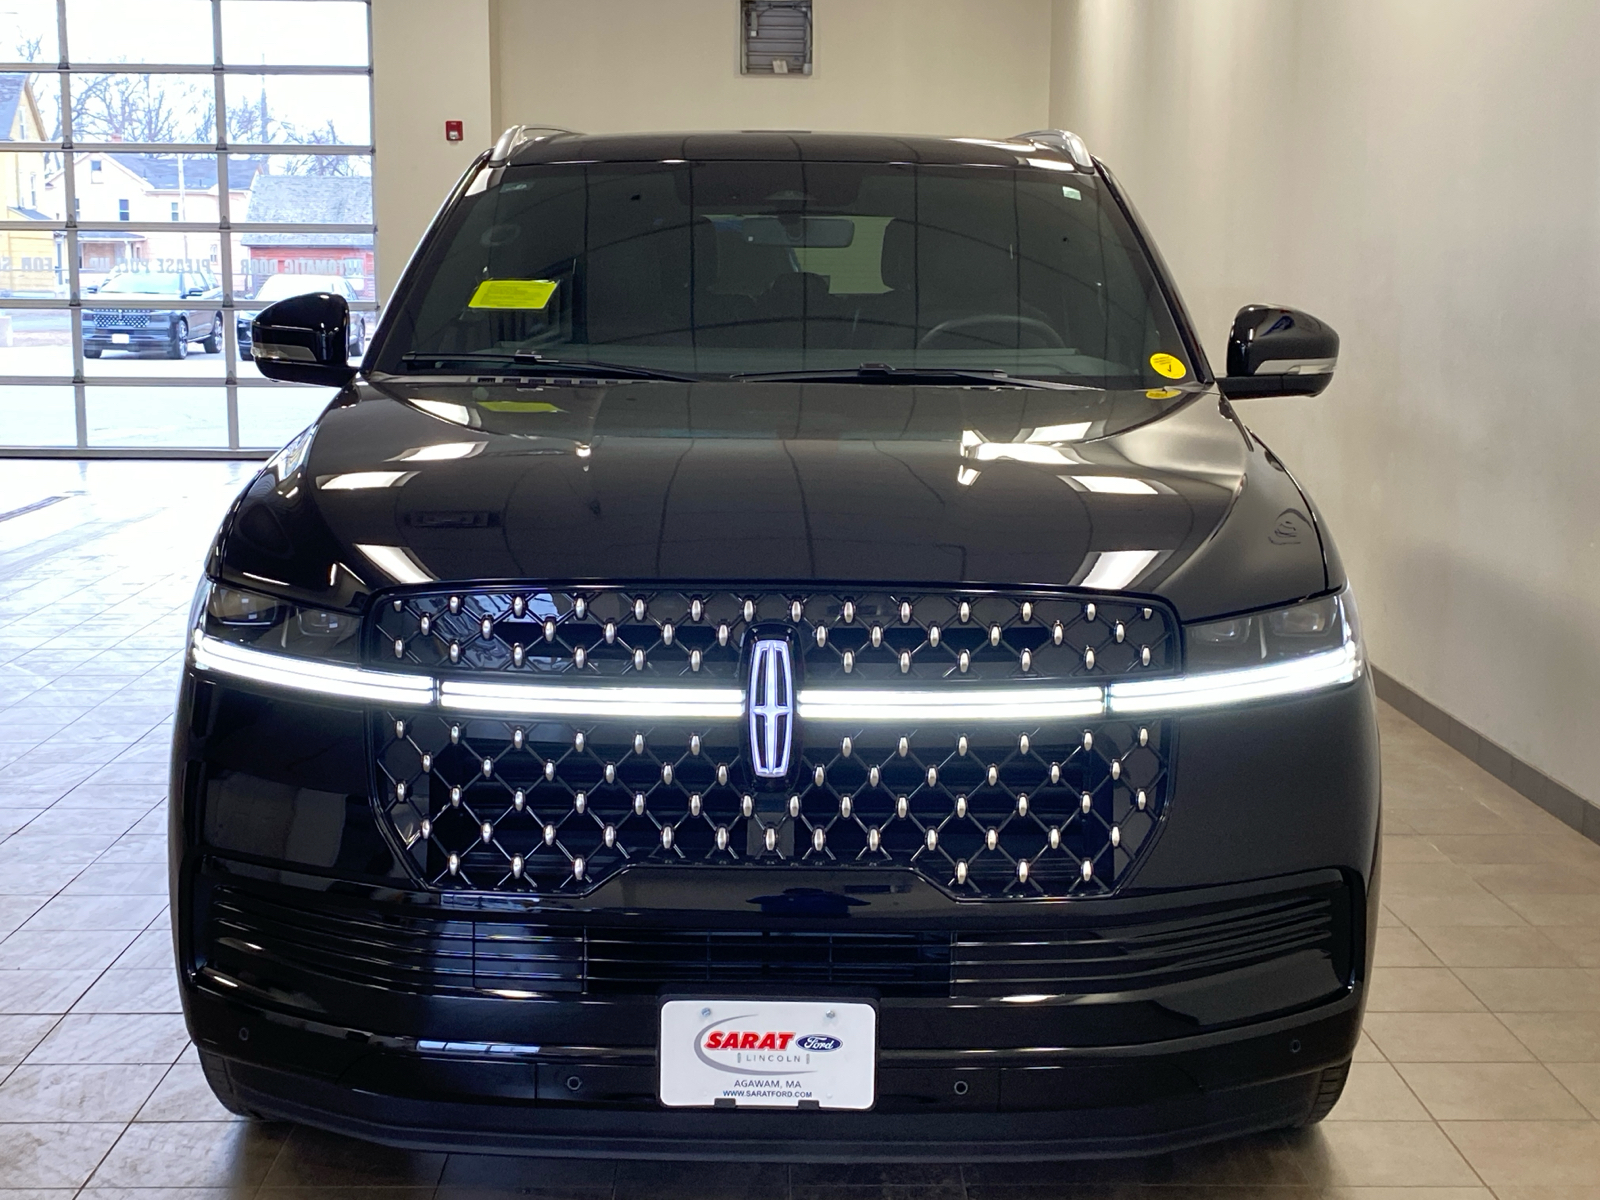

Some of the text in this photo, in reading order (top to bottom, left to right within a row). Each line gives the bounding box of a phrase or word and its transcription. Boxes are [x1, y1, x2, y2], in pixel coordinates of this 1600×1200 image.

[705, 1031, 834, 1051] SARAT Ford
[746, 1054, 801, 1063] LINCOLN
[734, 1079, 802, 1090] AGAWAM, MA
[722, 1090, 813, 1099] WWW.SARATFORD.COM
